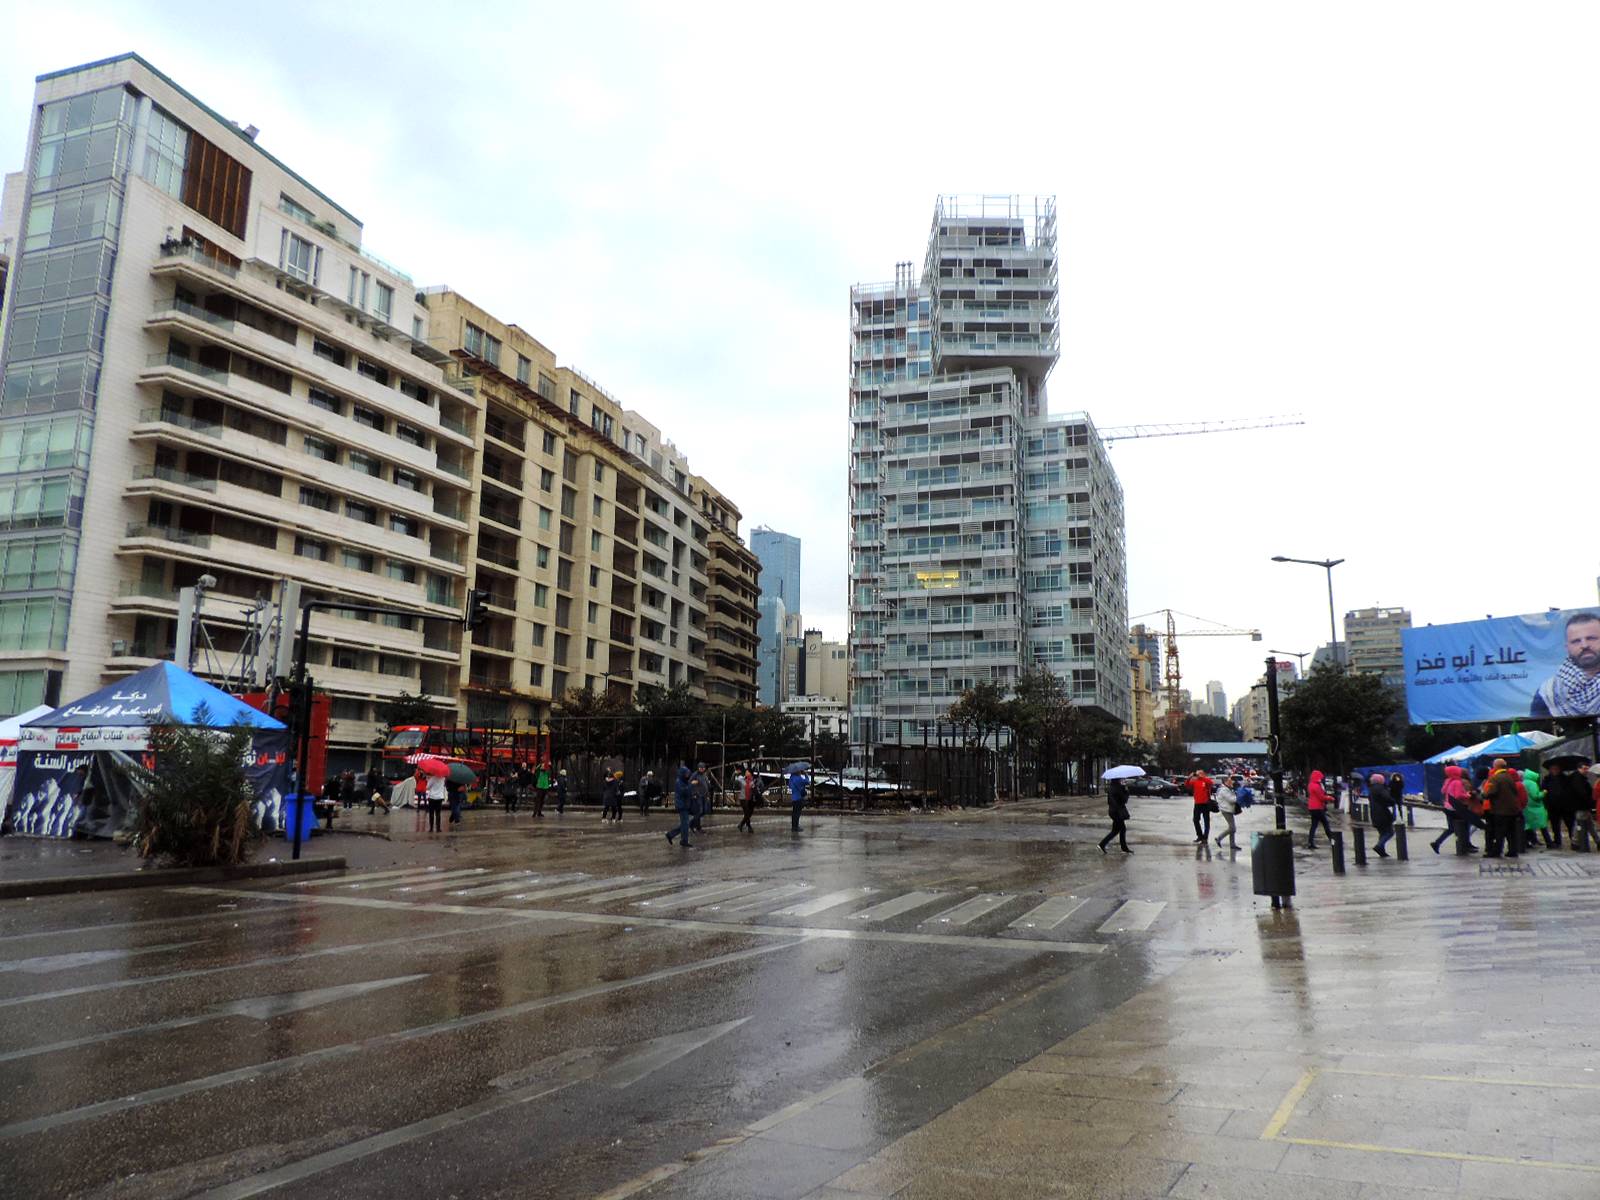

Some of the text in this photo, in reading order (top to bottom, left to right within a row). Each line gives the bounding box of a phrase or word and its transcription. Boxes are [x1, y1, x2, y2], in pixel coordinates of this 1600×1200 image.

[1415, 644, 1527, 676] علاء أبو فخر
[34, 752, 67, 770] السنة
